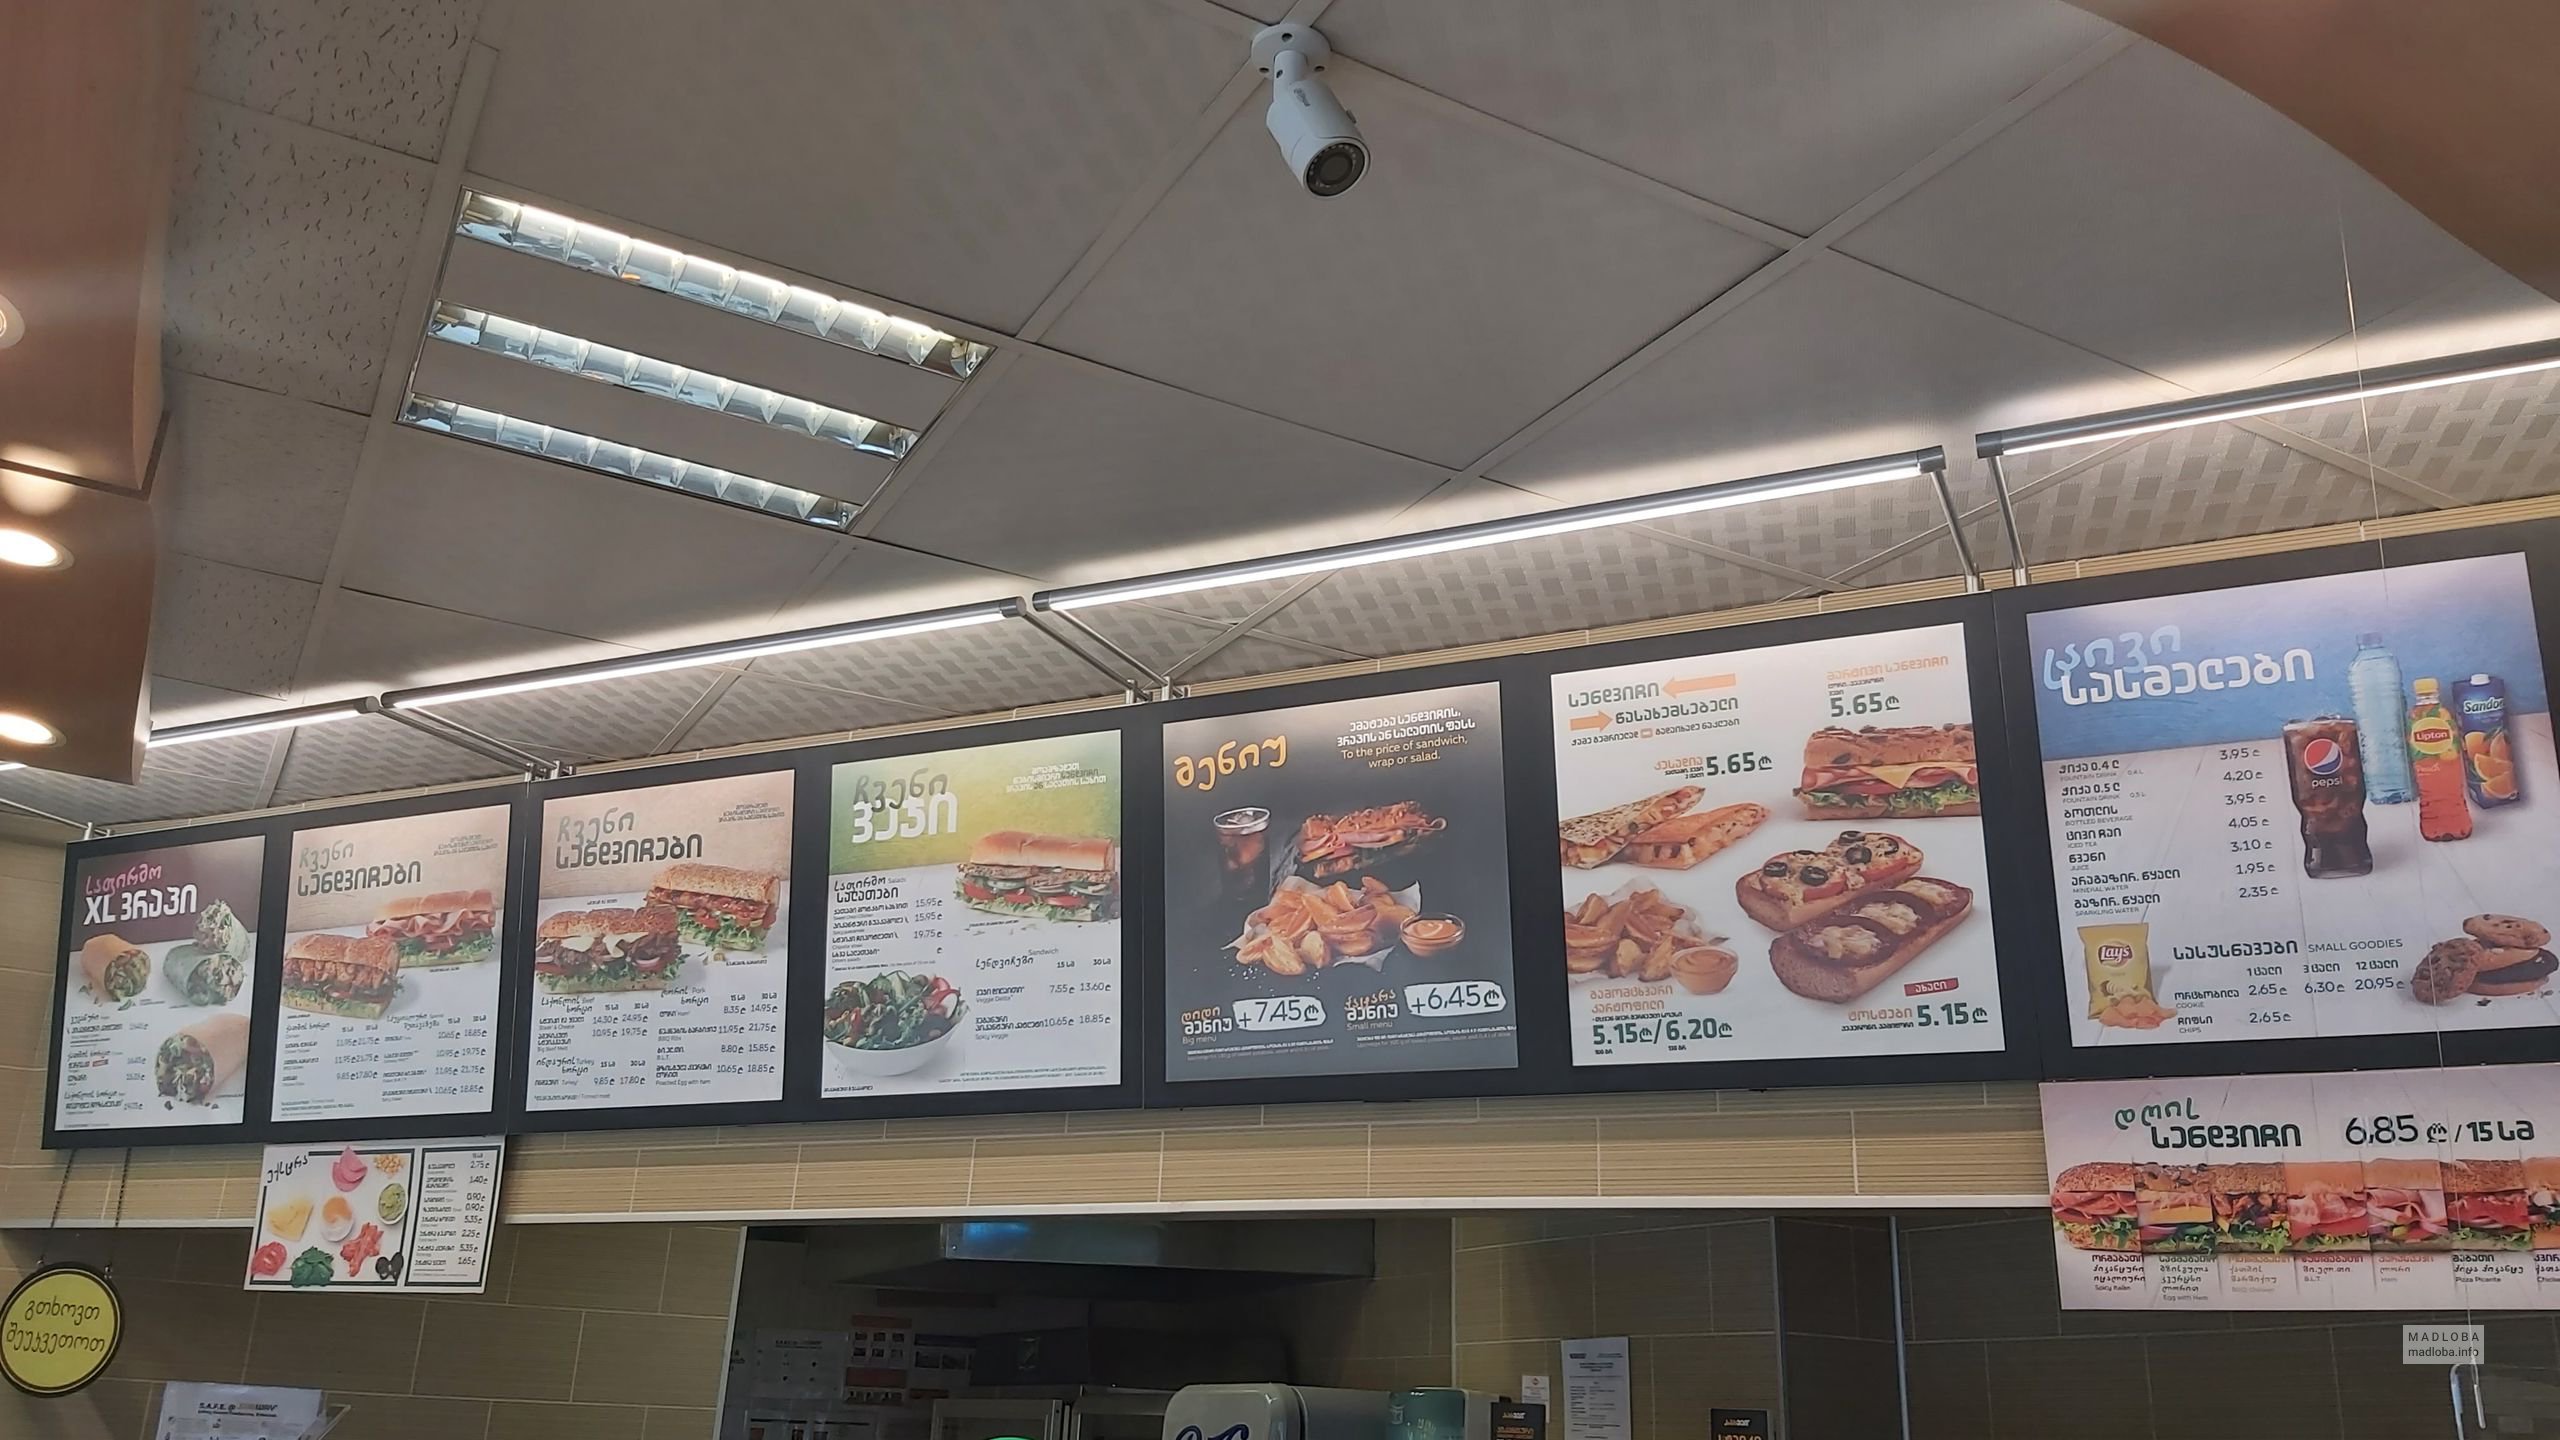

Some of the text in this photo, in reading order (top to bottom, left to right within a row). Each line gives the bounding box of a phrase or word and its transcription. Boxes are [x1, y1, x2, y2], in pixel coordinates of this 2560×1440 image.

[1885, 656, 1949, 673] სენდვიჩი
[2043, 624, 2181, 690] ცივი
[2060, 648, 2315, 706] სასმელები
[1568, 682, 1659, 708] სენდვიჩი
[1350, 716, 1396, 732] ემატება
[1378, 730, 1392, 740] ან
[1393, 723, 1444, 739] სალათის
[1445, 718, 1475, 731] ფასს
[2416, 730, 2448, 741] Lipton
[1341, 734, 1468, 759] To the price of sandwich,
[1174, 735, 1287, 791] მენიუ
[1368, 750, 1441, 769] wrap or salad.
[853, 768, 948, 813] ჩვენი
[2311, 777, 2343, 788] pepsi
[852, 791, 957, 844] ვეჯი
[2064, 805, 2118, 819] ბოთლის
[2097, 815, 2133, 824] BEVERAGE
[557, 807, 635, 846] ჩვენი
[2066, 828, 2122, 841] ცივი ჩაი
[299, 840, 354, 873] ჩვენი
[556, 833, 702, 870] სენდვიჩები
[2069, 852, 2106, 864] წვენი
[85, 863, 162, 897] საფირმო
[297, 861, 421, 897] სენდვიჩები
[2141, 868, 2181, 881] წყალი
[834, 875, 886, 892] საფირმო
[2072, 886, 2103, 894] MINERAL
[836, 887, 899, 903] სალათები
[2122, 893, 2161, 905] წყალი
[83, 895, 116, 925] XL
[2075, 909, 2114, 917] SPARKLING
[1028, 948, 1059, 956] Sandwich
[2173, 938, 2403, 960] სასუსნავები SMALL GOODIES
[2253, 966, 2282, 976] ცალი
[2311, 963, 2340, 973] ცალი
[2356, 959, 2399, 970] 12 ცალი
[1915, 980, 1948, 993] ახალი
[1346, 1003, 1398, 1021] მენიუ
[1591, 1000, 1665, 1014] კარტოფილი
[2176, 1001, 2205, 1009] COOKIE
[1181, 1006, 1221, 1024] დიდი
[1848, 1007, 1913, 1022] ტოსტები
[1184, 1017, 1233, 1035] მენიუ
[1346, 1020, 1393, 1031] Small menu
[2179, 1026, 2202, 1034] CHIPS
[1182, 1035, 1217, 1046] Big menu
[2115, 1097, 2200, 1130] დღის
[2151, 1123, 2301, 1149] სენდვიჩი
[2466, 1121, 2493, 1142] 15
[2497, 1120, 2535, 1141] სმ
[267, 1155, 309, 1183] ექსტრა
[2452, 1254, 2495, 1263] შაბათი
[24, 1295, 100, 1326] გთხოვთ
[6, 1322, 105, 1354] შეუკვეთოთ
